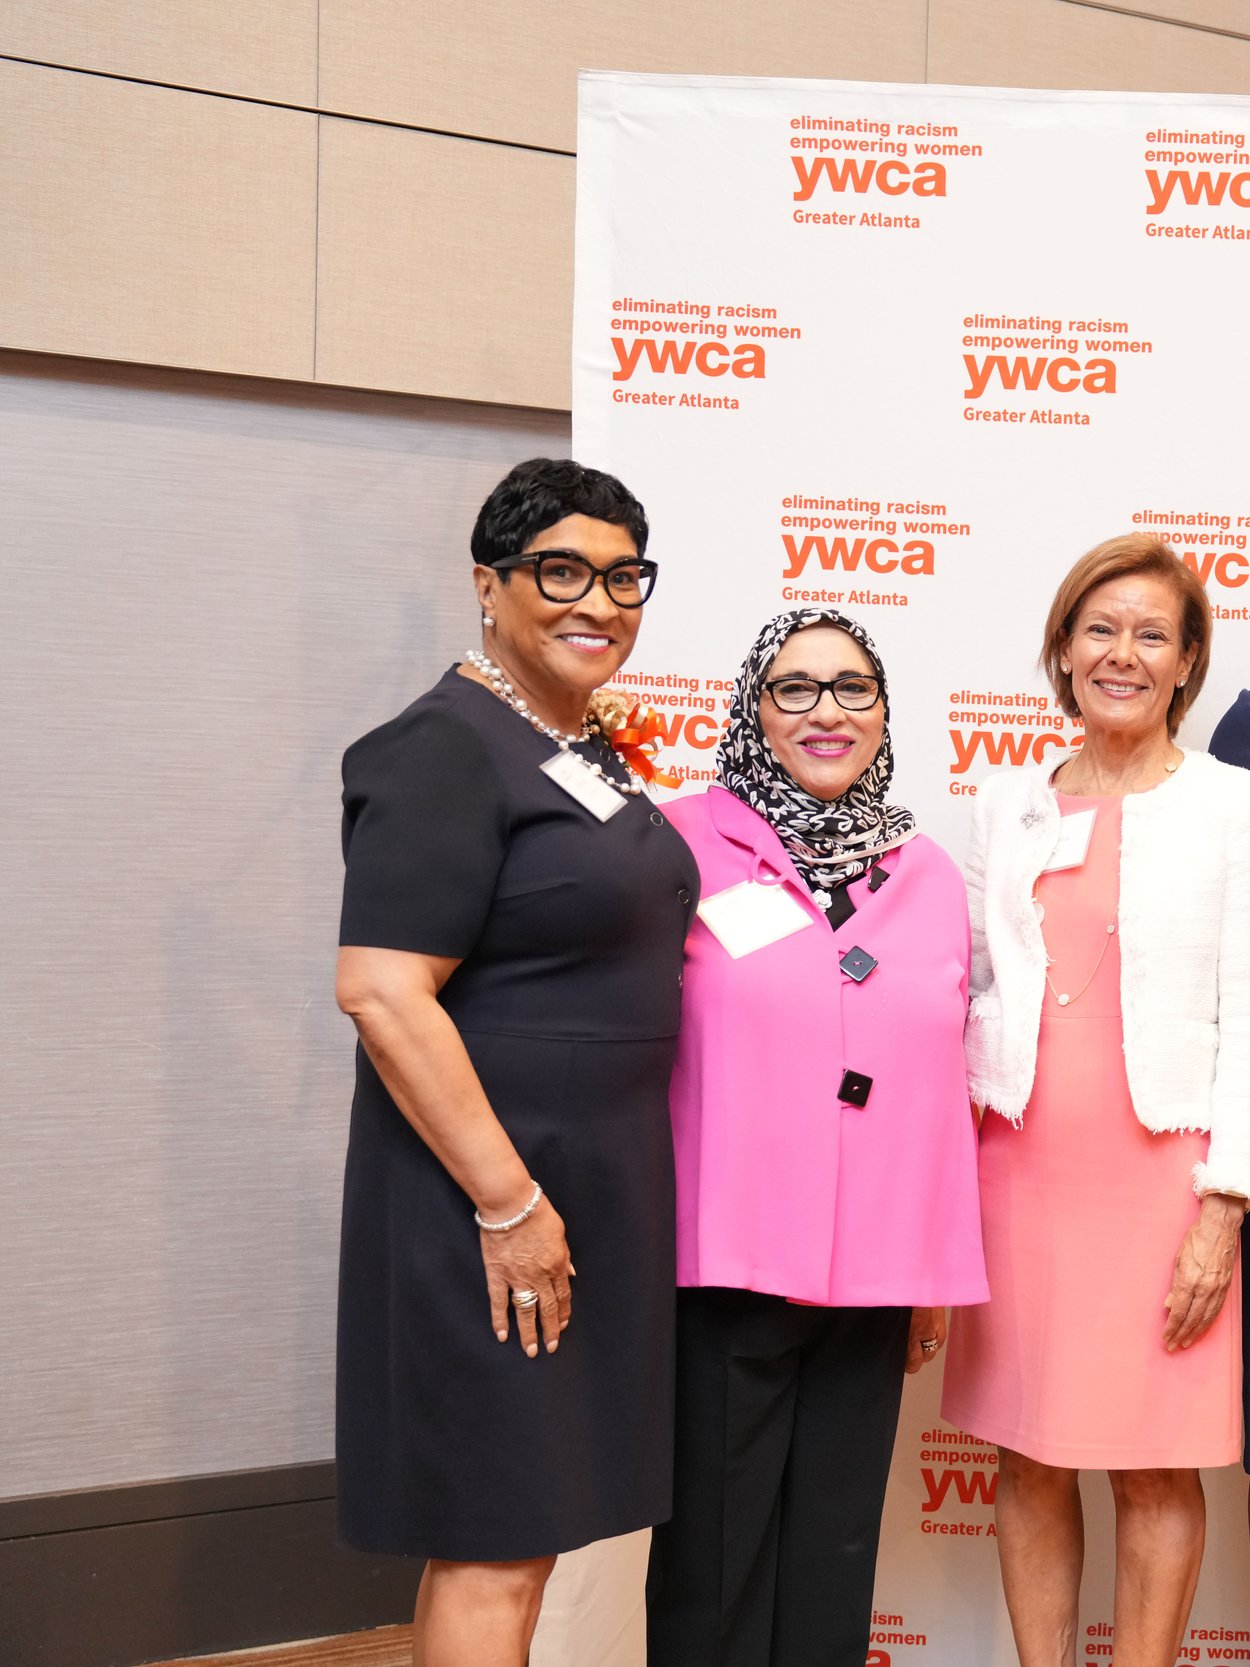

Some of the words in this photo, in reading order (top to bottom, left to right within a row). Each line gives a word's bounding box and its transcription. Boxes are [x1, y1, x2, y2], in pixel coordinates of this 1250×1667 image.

[790, 115, 890, 137] eliminating
[896, 122, 958, 137] racism
[789, 136, 907, 157] empowering
[913, 143, 983, 157] women
[1146, 129, 1245, 149] eliminating
[790, 156, 946, 201] ywca
[793, 209, 856, 226] Greater
[860, 212, 920, 229] Atlanta
[1145, 223, 1209, 239] Greater
[612, 297, 711, 319] eliminating
[717, 304, 777, 319] racism
[610, 319, 727, 339] empowering
[733, 325, 802, 340] women
[963, 314, 1062, 335] eliminating
[1068, 319, 1129, 334] racism
[961, 335, 1078, 355] empowering
[1084, 339, 1153, 353] women
[611, 337, 765, 381] ywca
[963, 354, 1116, 399] ywca
[612, 388, 675, 407] Greater
[679, 392, 739, 410] Atlanta
[963, 406, 1026, 424] Greater
[1029, 408, 1090, 426] Atlanta
[782, 496, 880, 516] eliminating
[886, 500, 947, 516] racism
[780, 516, 896, 536] empowering
[903, 521, 971, 536] women
[1131, 509, 1231, 530] eliminating
[782, 534, 935, 579] ywca
[782, 586, 844, 604] Greater
[848, 589, 908, 607] Atlanta
[608, 670, 699, 692] liminating
[706, 679, 734, 693] rac
[949, 690, 1048, 711] eliminating
[948, 711, 1065, 730] empowering
[668, 765, 717, 781] Atlant
[921, 1429, 998, 1446] elimina
[920, 1449, 999, 1465] empowe
[920, 1468, 999, 1512] yw
[921, 1519, 984, 1536] Greater
[872, 1610, 904, 1627] ism
[1189, 1626, 1250, 1642] racism
